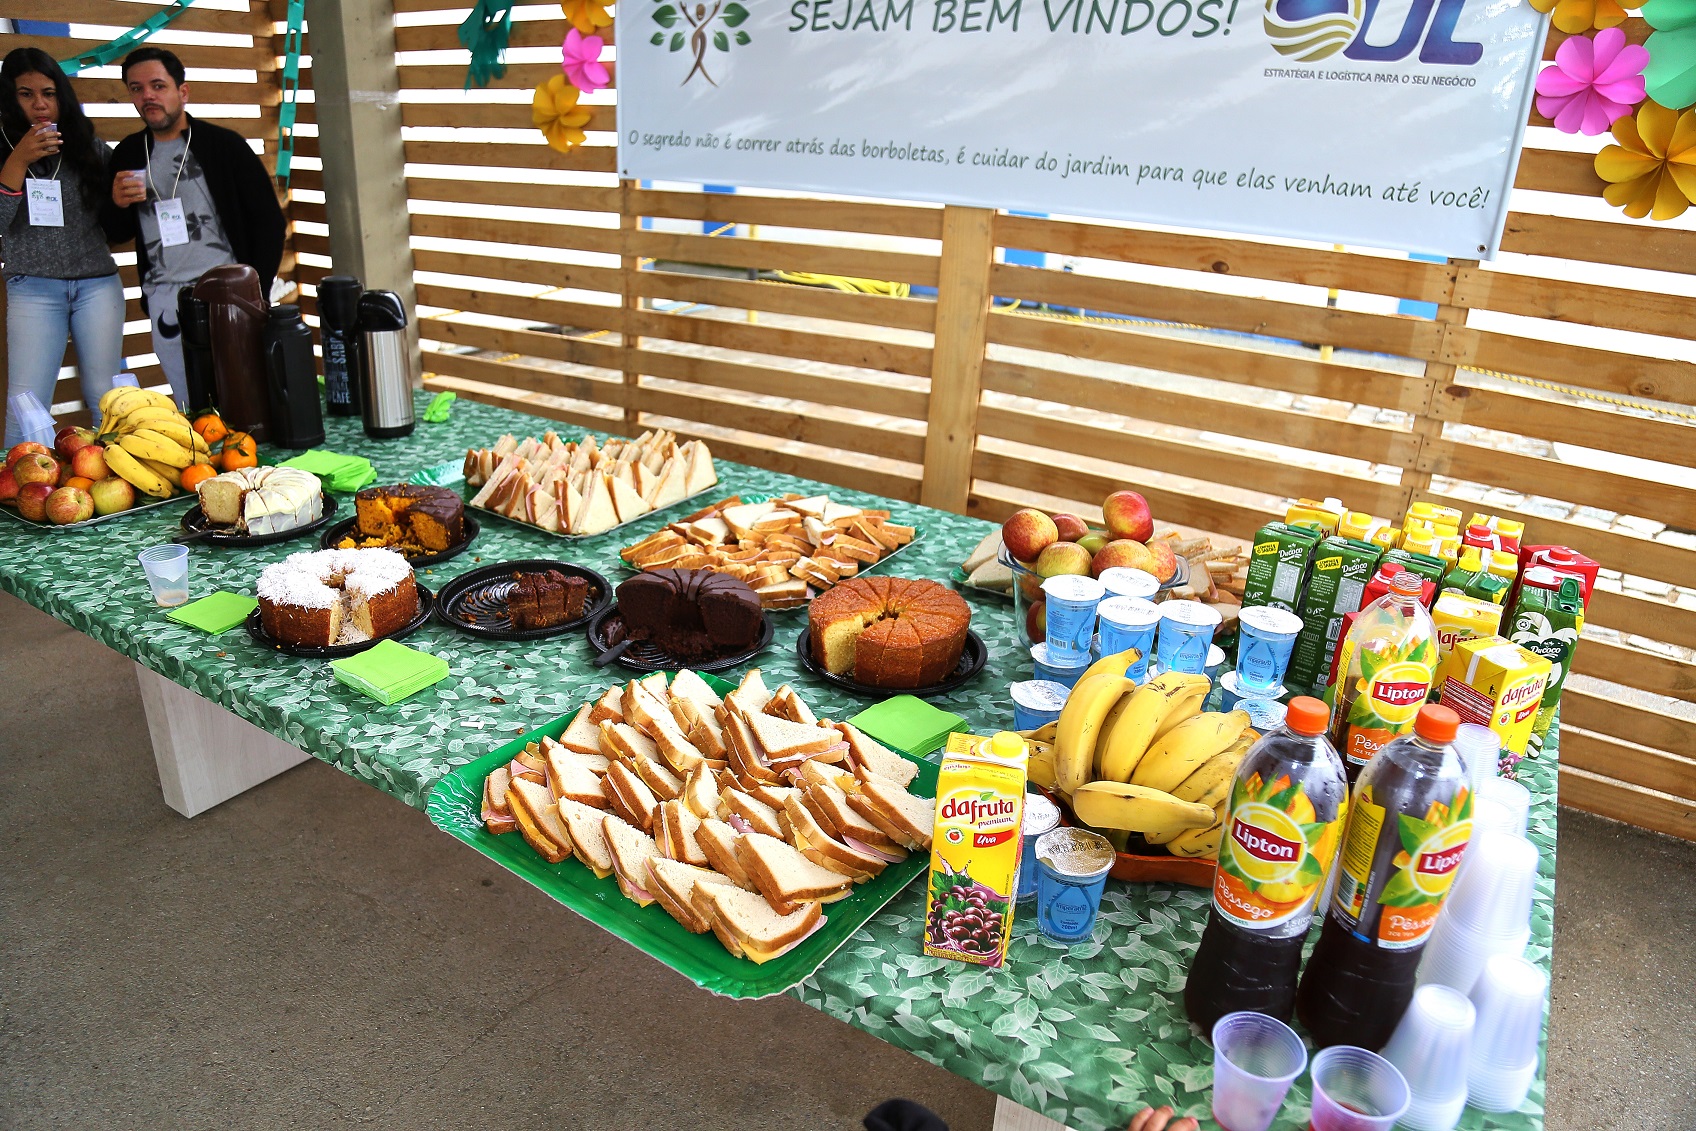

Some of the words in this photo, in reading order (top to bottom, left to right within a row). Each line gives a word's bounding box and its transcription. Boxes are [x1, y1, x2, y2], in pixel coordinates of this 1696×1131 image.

[788, 0, 912, 32] SEJAM
[932, 0, 1021, 33] BEM
[1046, 0, 1238, 38] VINDOS!
[1263, 68, 1316, 80] ESTRATÉGIA
[1318, 70, 1324, 80] E
[1326, 70, 1372, 83] LOGÍSTICA
[1374, 73, 1399, 84] PARA
[1402, 74, 1410, 84] O
[1412, 75, 1429, 86] SEU
[1431, 75, 1477, 87] NEGÓCIO
[628, 129, 640, 146] O
[643, 130, 692, 151] segredo
[696, 132, 720, 149] não
[724, 132, 732, 150] é
[737, 137, 782, 153] correr
[786, 137, 825, 155] atrás
[830, 138, 856, 157] das
[861, 139, 950, 166] borboletas,
[957, 145, 966, 165] é
[972, 147, 1030, 169] cuidar
[1035, 151, 1058, 171] do
[1061, 153, 1130, 179] jardim
[1136, 163, 1184, 185] para
[1193, 168, 1228, 190] que
[1236, 167, 1276, 190] elas
[1284, 173, 1373, 198] venham
[1382, 181, 1421, 203] até
[1430, 186, 1490, 210] você!
[1278, 547, 1304, 558] Ducoco
[1341, 562, 1368, 573] Ducoco
[1530, 645, 1562, 655] Ducoco
[1377, 685, 1425, 701] Lipton
[1501, 679, 1544, 705] dafruta
[941, 798, 1014, 824] dafruta
[977, 817, 1013, 829] premium
[976, 834, 997, 846] Uva
[1235, 823, 1294, 858] Lipton
[1218, 875, 1275, 920] Pêssego
